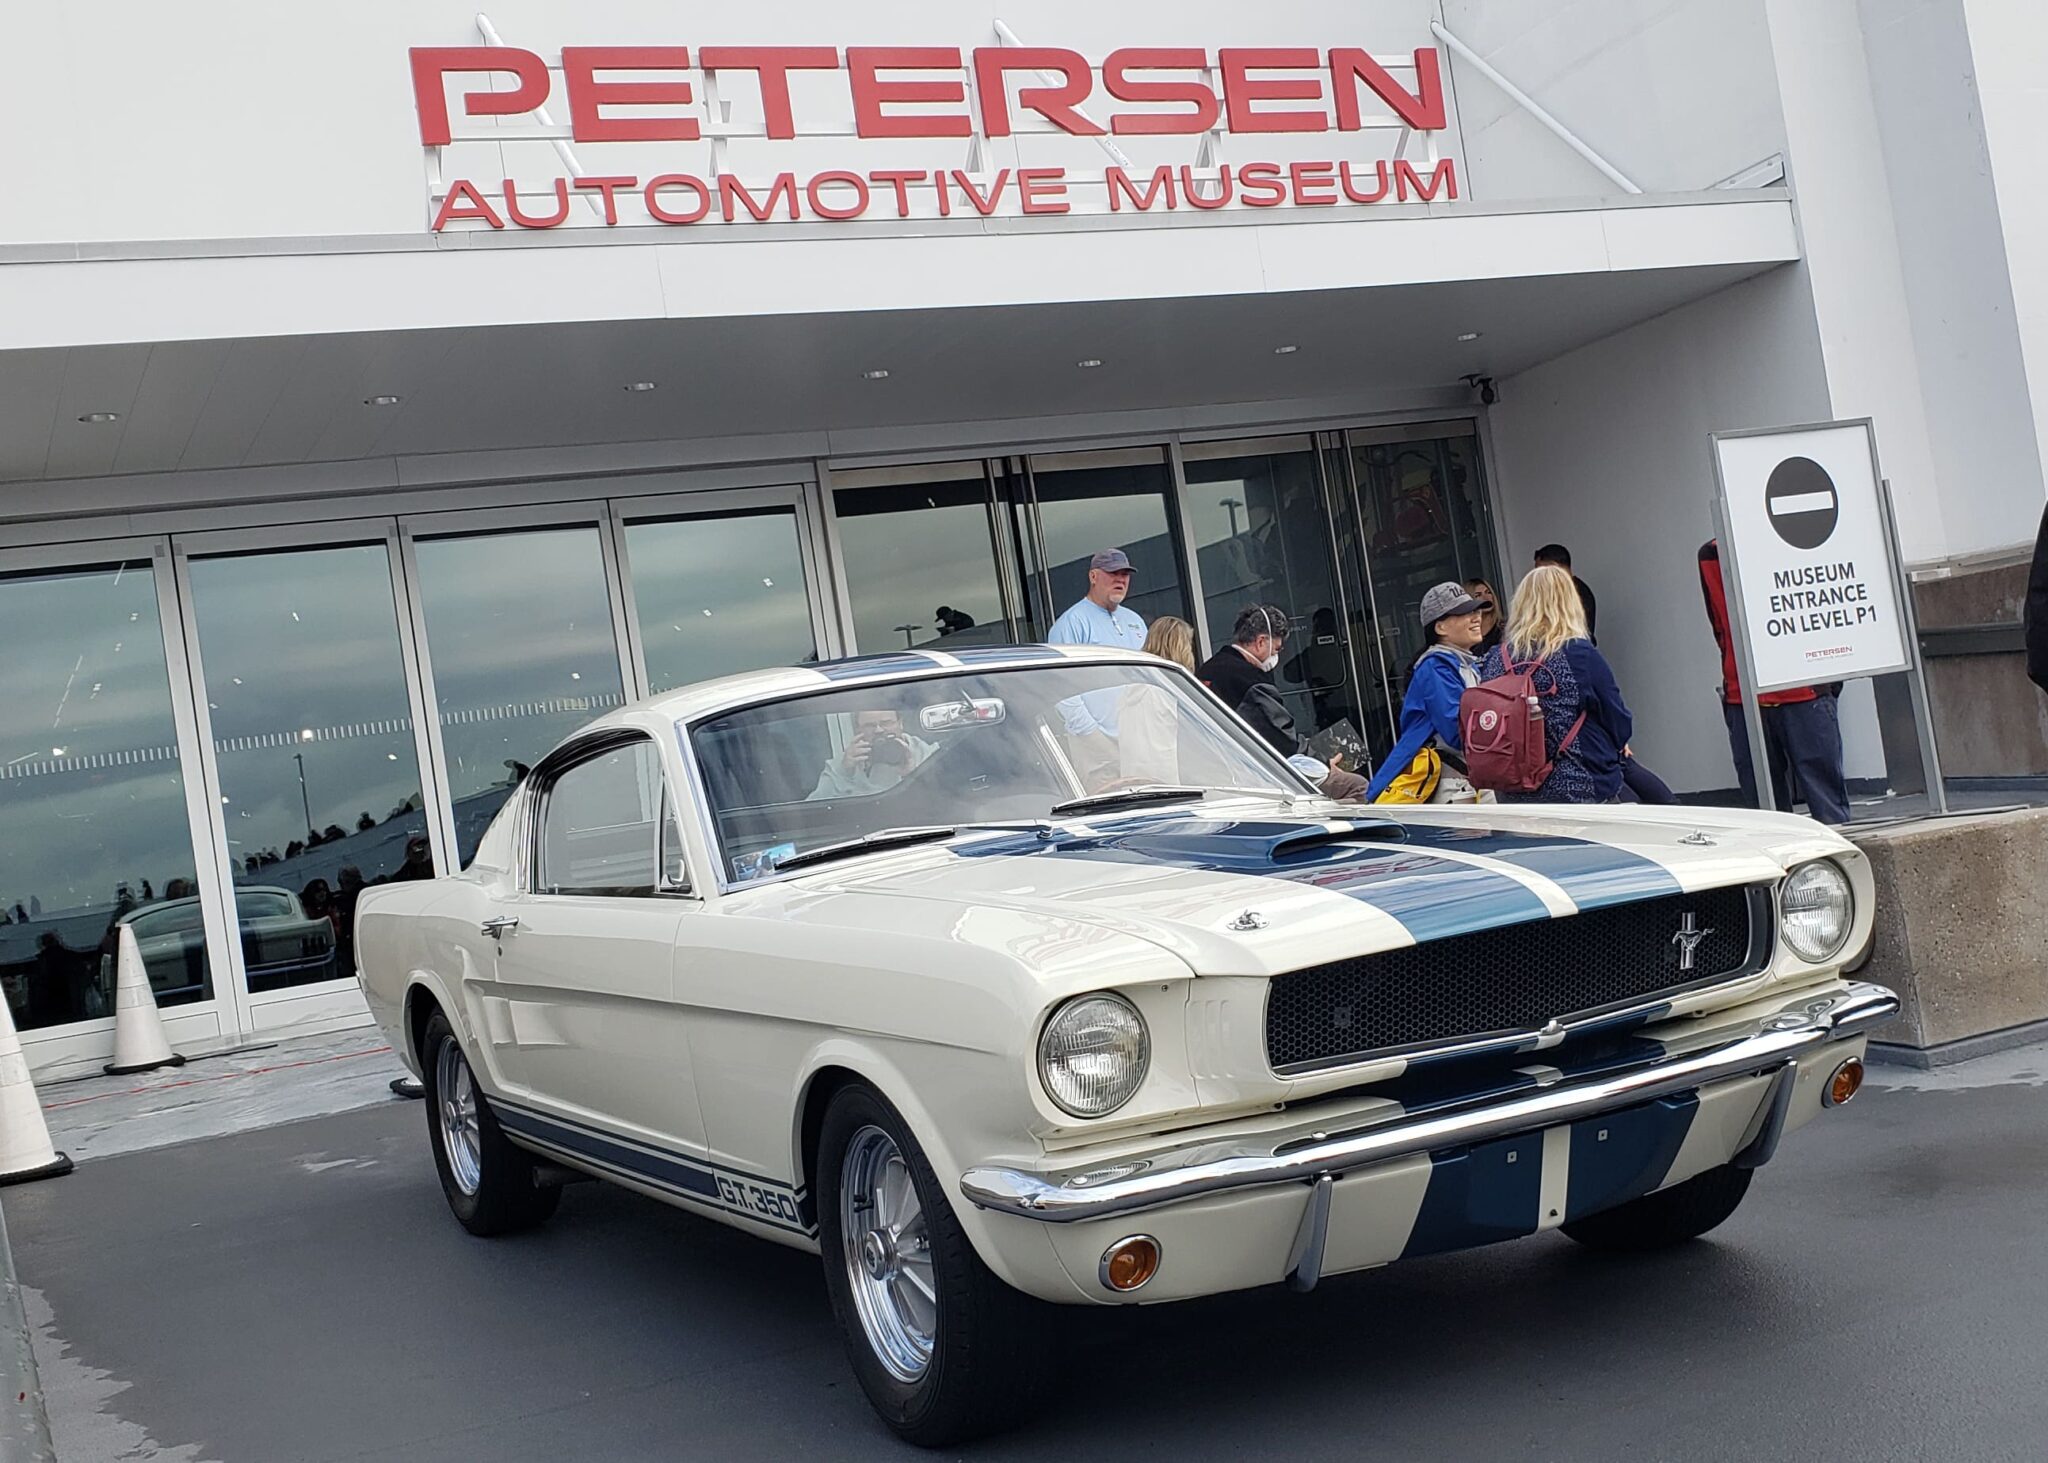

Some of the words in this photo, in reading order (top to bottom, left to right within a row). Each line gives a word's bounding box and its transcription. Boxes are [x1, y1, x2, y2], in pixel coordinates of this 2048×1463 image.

[409, 46, 1448, 147] PETERSEN
[431, 167, 1072, 233] AUTOMOTIVE
[1105, 157, 1459, 212] MUSEUM
[1773, 561, 1856, 589] MUSEUM
[1769, 583, 1868, 613] ENTRANCE
[1766, 616, 1797, 637] ON
[1799, 609, 1854, 632] LEVEL
[1855, 604, 1877, 624] P1
[1805, 646, 1853, 659] PETERSEN
